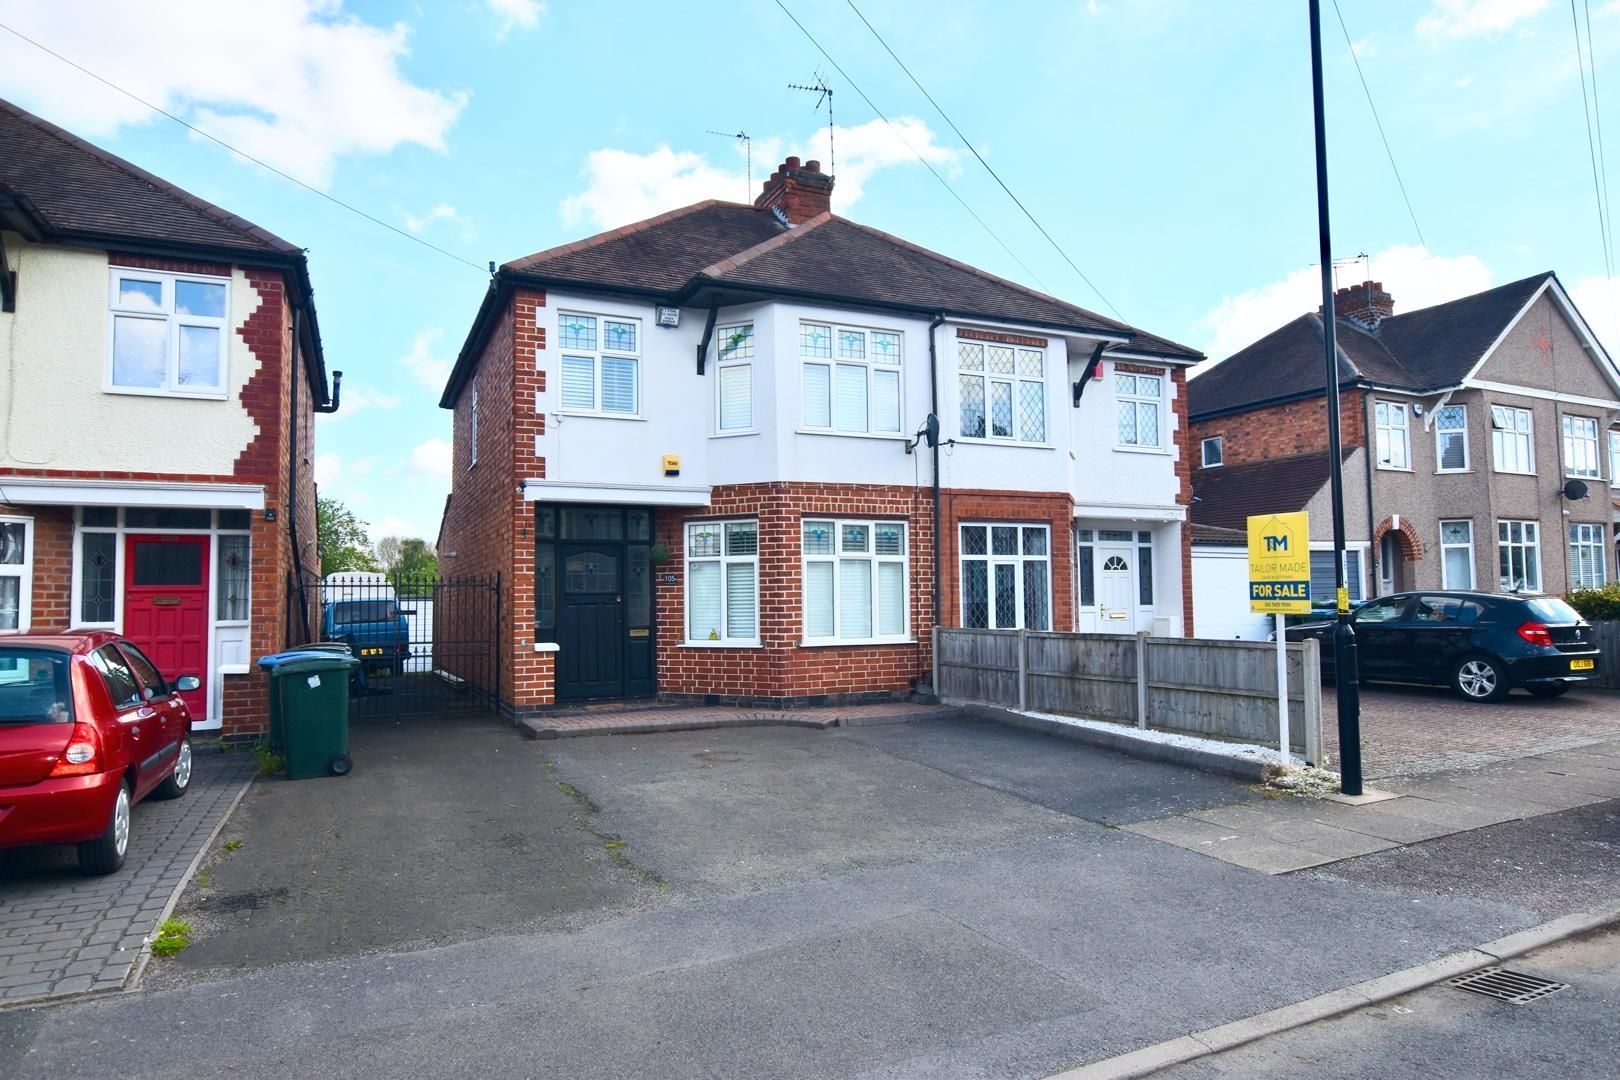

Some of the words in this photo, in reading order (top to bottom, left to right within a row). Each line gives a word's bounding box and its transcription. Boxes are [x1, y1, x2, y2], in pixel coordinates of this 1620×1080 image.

[1263, 535, 1288, 552] TM
[1251, 563, 1277, 573] TAILOR
[1279, 562, 1308, 573] MADE
[1252, 584, 1273, 598] FOR
[1274, 584, 1307, 598] SALE
